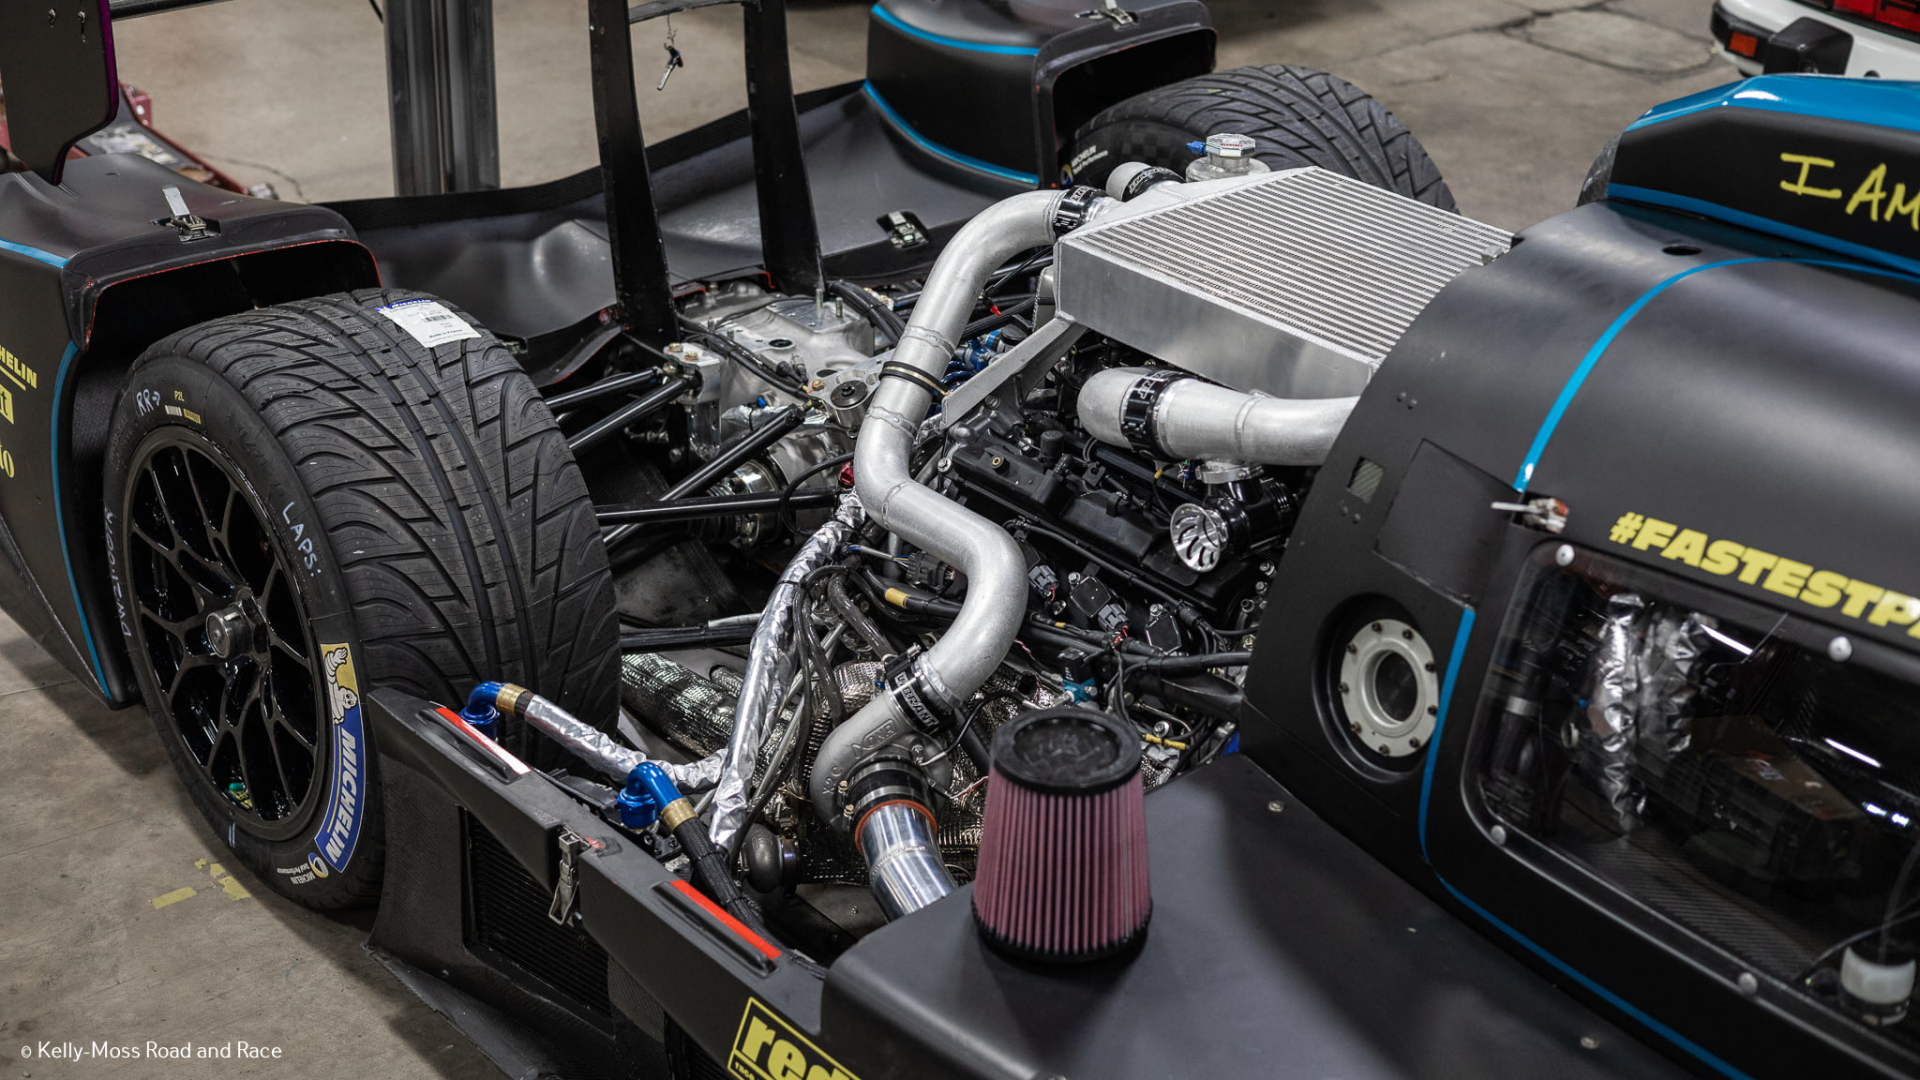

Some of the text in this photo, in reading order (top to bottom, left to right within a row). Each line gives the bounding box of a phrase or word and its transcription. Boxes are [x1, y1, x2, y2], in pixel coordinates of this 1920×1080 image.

[1780, 153, 1920, 231] I AM
[282, 501, 321, 577] LAPS:
[1609, 511, 1920, 640] #FASTESTP
[325, 727, 358, 864] MICHELIN
[290, 870, 316, 885] MICHELIN
